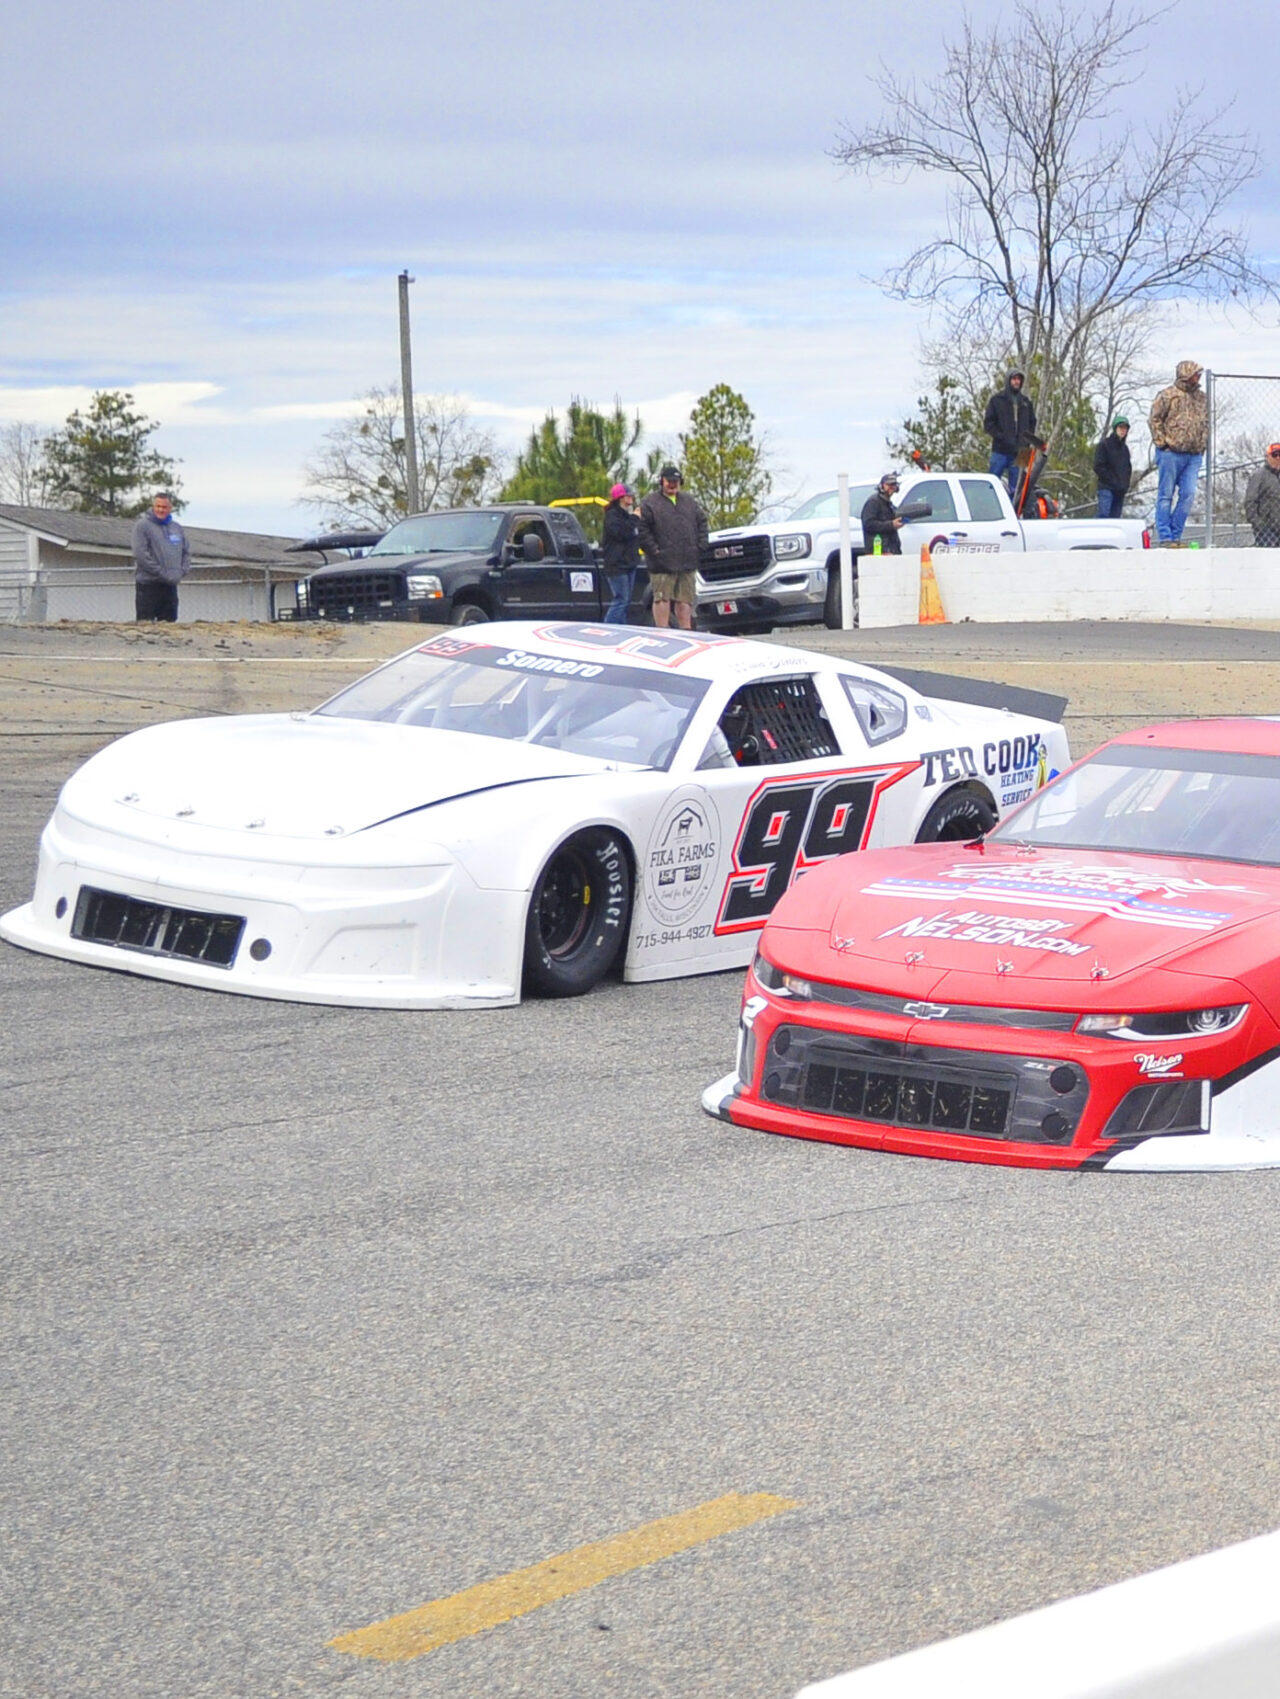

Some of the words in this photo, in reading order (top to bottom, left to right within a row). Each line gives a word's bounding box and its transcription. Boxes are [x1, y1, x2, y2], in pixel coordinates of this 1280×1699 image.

[496, 650, 604, 678] Somero
[920, 746, 978, 788] TED
[983, 733, 1040, 776] COOK
[1001, 769, 1034, 788] HEATING
[650, 849, 674, 868] FIKA
[678, 842, 715, 863] FARMS
[715, 766, 884, 934] 99
[596, 841, 625, 927] Hoosier
[636, 925, 712, 949] 715-944-4927
[1133, 1053, 1184, 1073] Nelson
